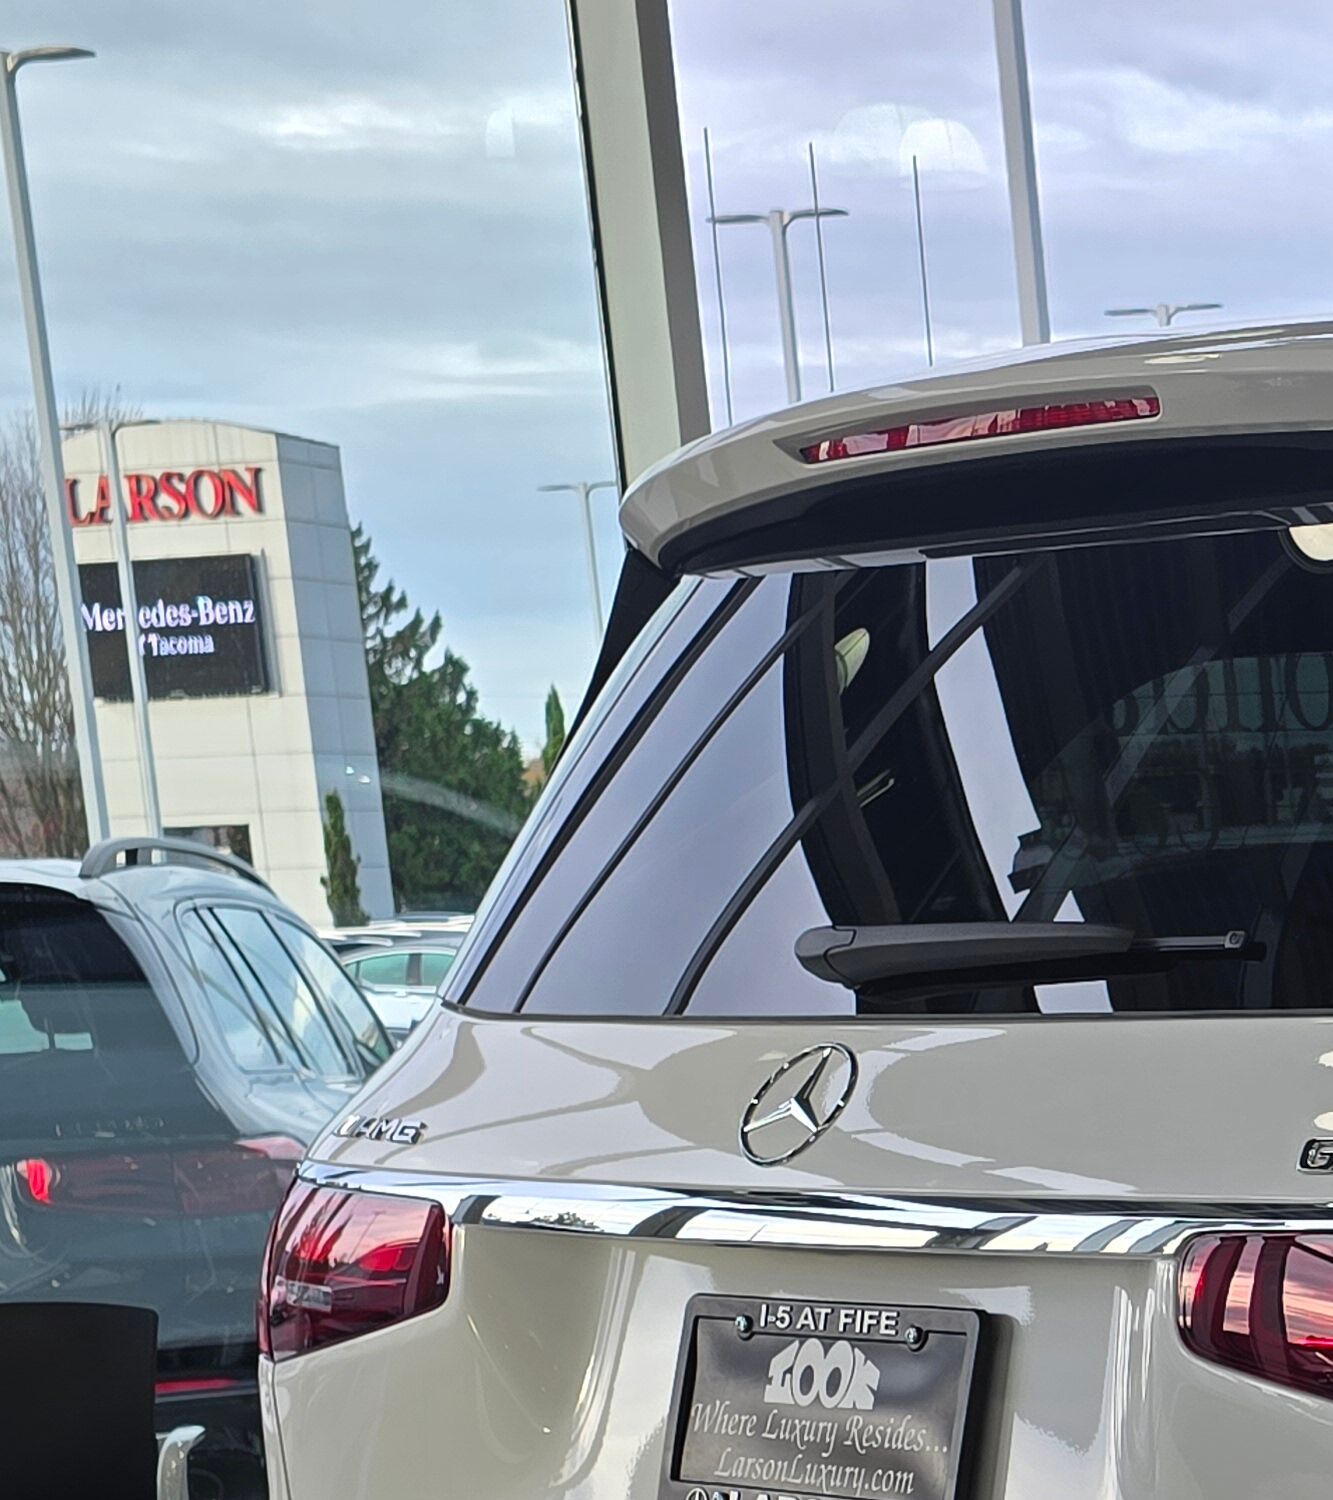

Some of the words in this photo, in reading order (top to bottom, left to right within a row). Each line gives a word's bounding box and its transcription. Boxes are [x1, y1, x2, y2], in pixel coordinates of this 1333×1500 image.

[65, 467, 263, 528] LARSON
[80, 596, 255, 632] Meredes-Benz
[353, 1116, 429, 1145] AMG
[759, 1303, 792, 1328] I-5
[795, 1307, 832, 1331] AT
[838, 1311, 899, 1336] FIFE
[690, 1399, 757, 1438] Where
[762, 1409, 839, 1457] Luxury
[843, 1415, 949, 1455] Resides...
[713, 1448, 915, 1498] LarsonLuxury.com
